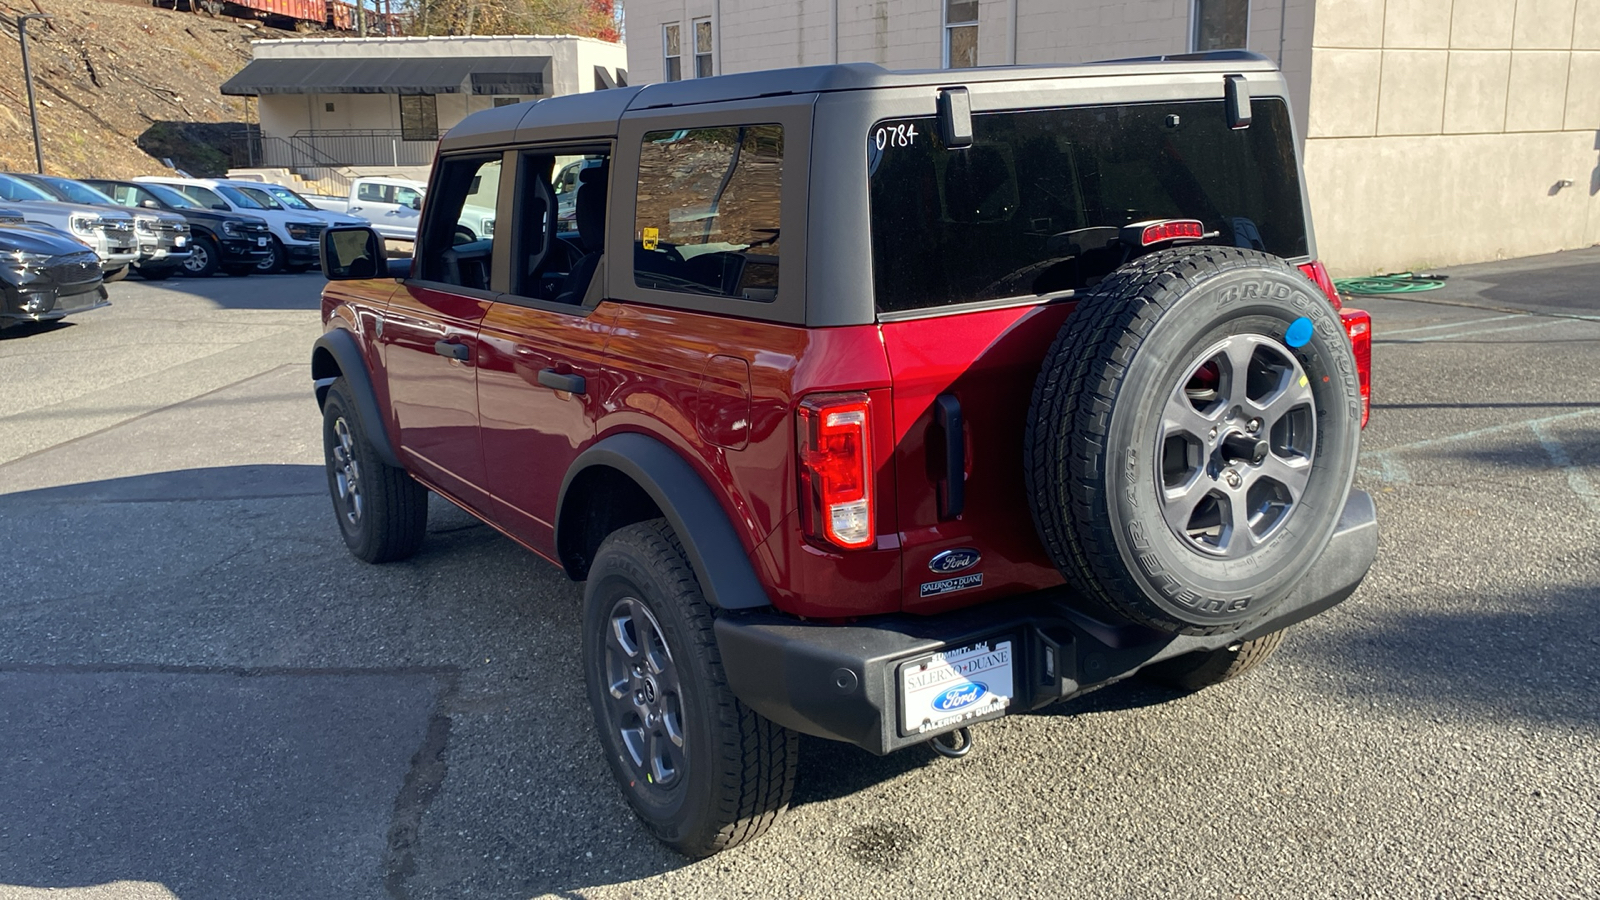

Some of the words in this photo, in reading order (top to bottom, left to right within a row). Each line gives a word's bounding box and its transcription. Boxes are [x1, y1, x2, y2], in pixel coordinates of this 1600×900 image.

[876, 124, 919, 151] 0784
[1124, 445, 1139, 508] A/T
[942, 553, 970, 570] Ford
[1126, 518, 1255, 614] DUELER
[922, 580, 953, 592] SALERNO
[975, 641, 988, 651] NJ
[907, 664, 962, 690] SALERNO
[968, 650, 1008, 673] DUANE
[942, 686, 978, 710] Ford
[919, 714, 963, 734] SALERNO
[976, 701, 1006, 717] DUANE
